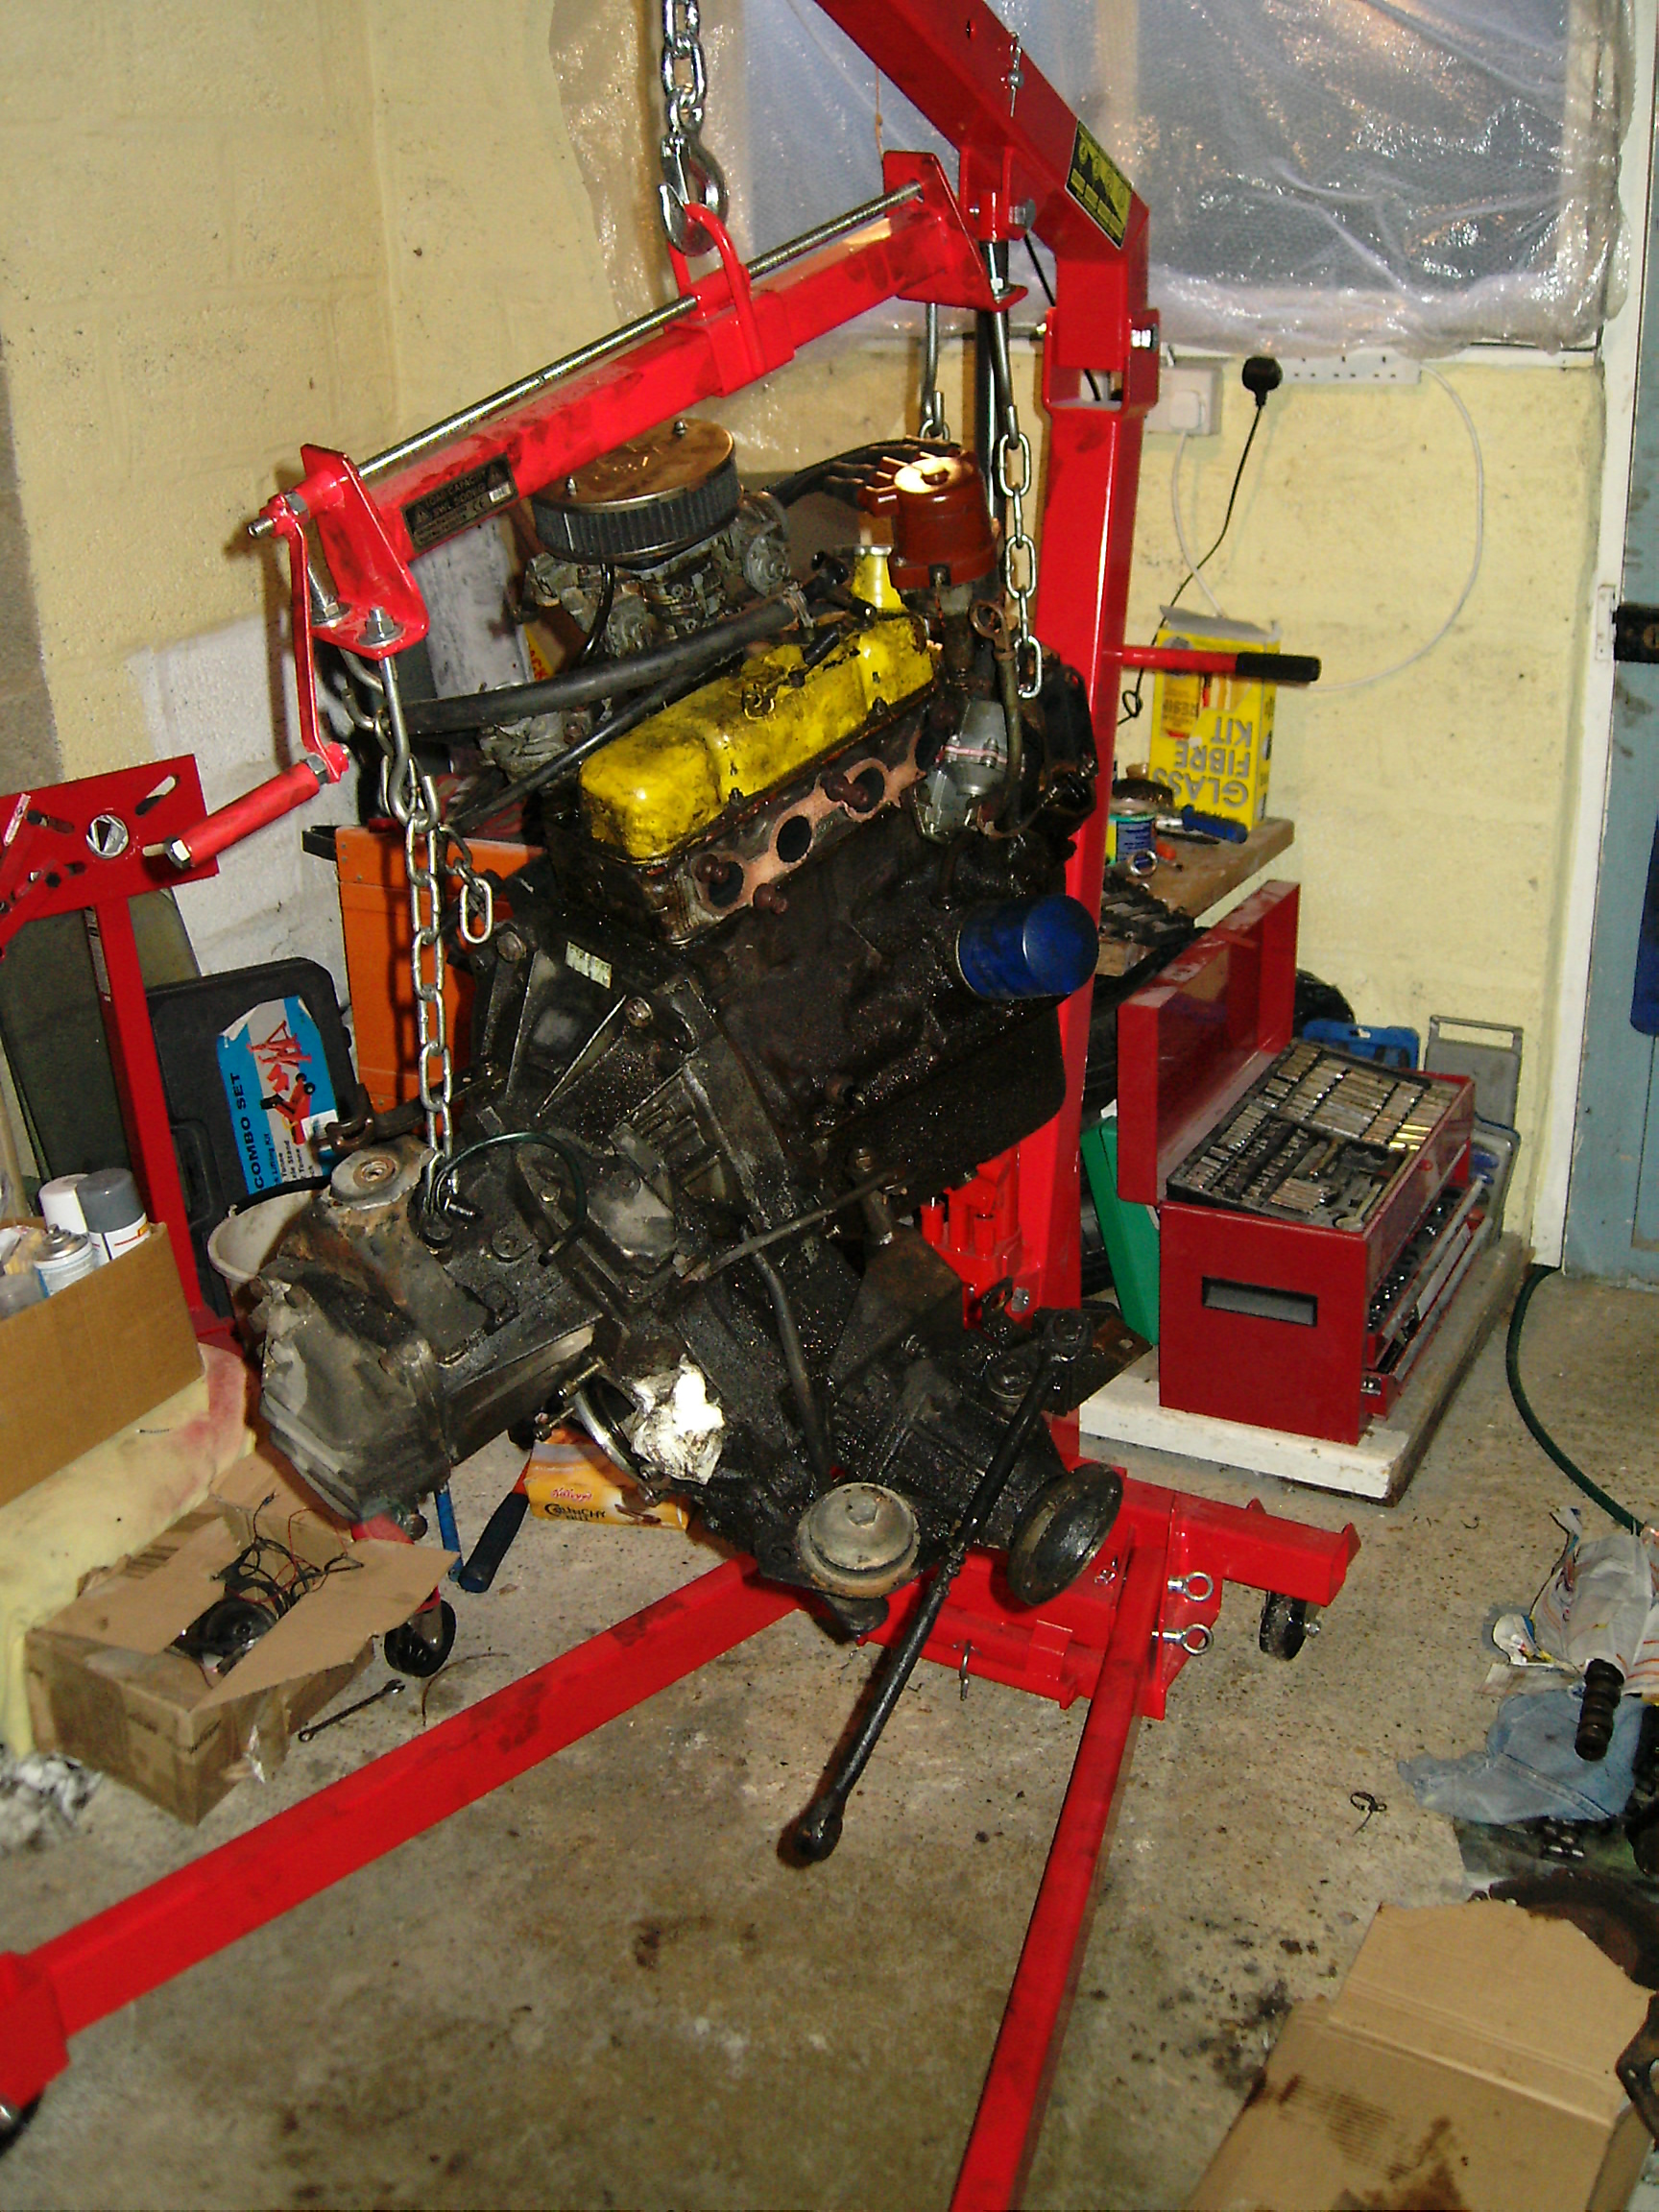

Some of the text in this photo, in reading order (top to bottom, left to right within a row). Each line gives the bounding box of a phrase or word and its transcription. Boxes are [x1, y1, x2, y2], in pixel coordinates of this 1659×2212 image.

[1210, 716, 1253, 747] KIT
[1174, 740, 1250, 779] FIBRE
[230, 1072, 264, 1190] COMBO SET
[267, 1146, 277, 1174] Lifting
[277, 1152, 287, 1177] Tonne
[283, 1140, 294, 1165] Stand
[295, 1148, 304, 1173] Tonne
